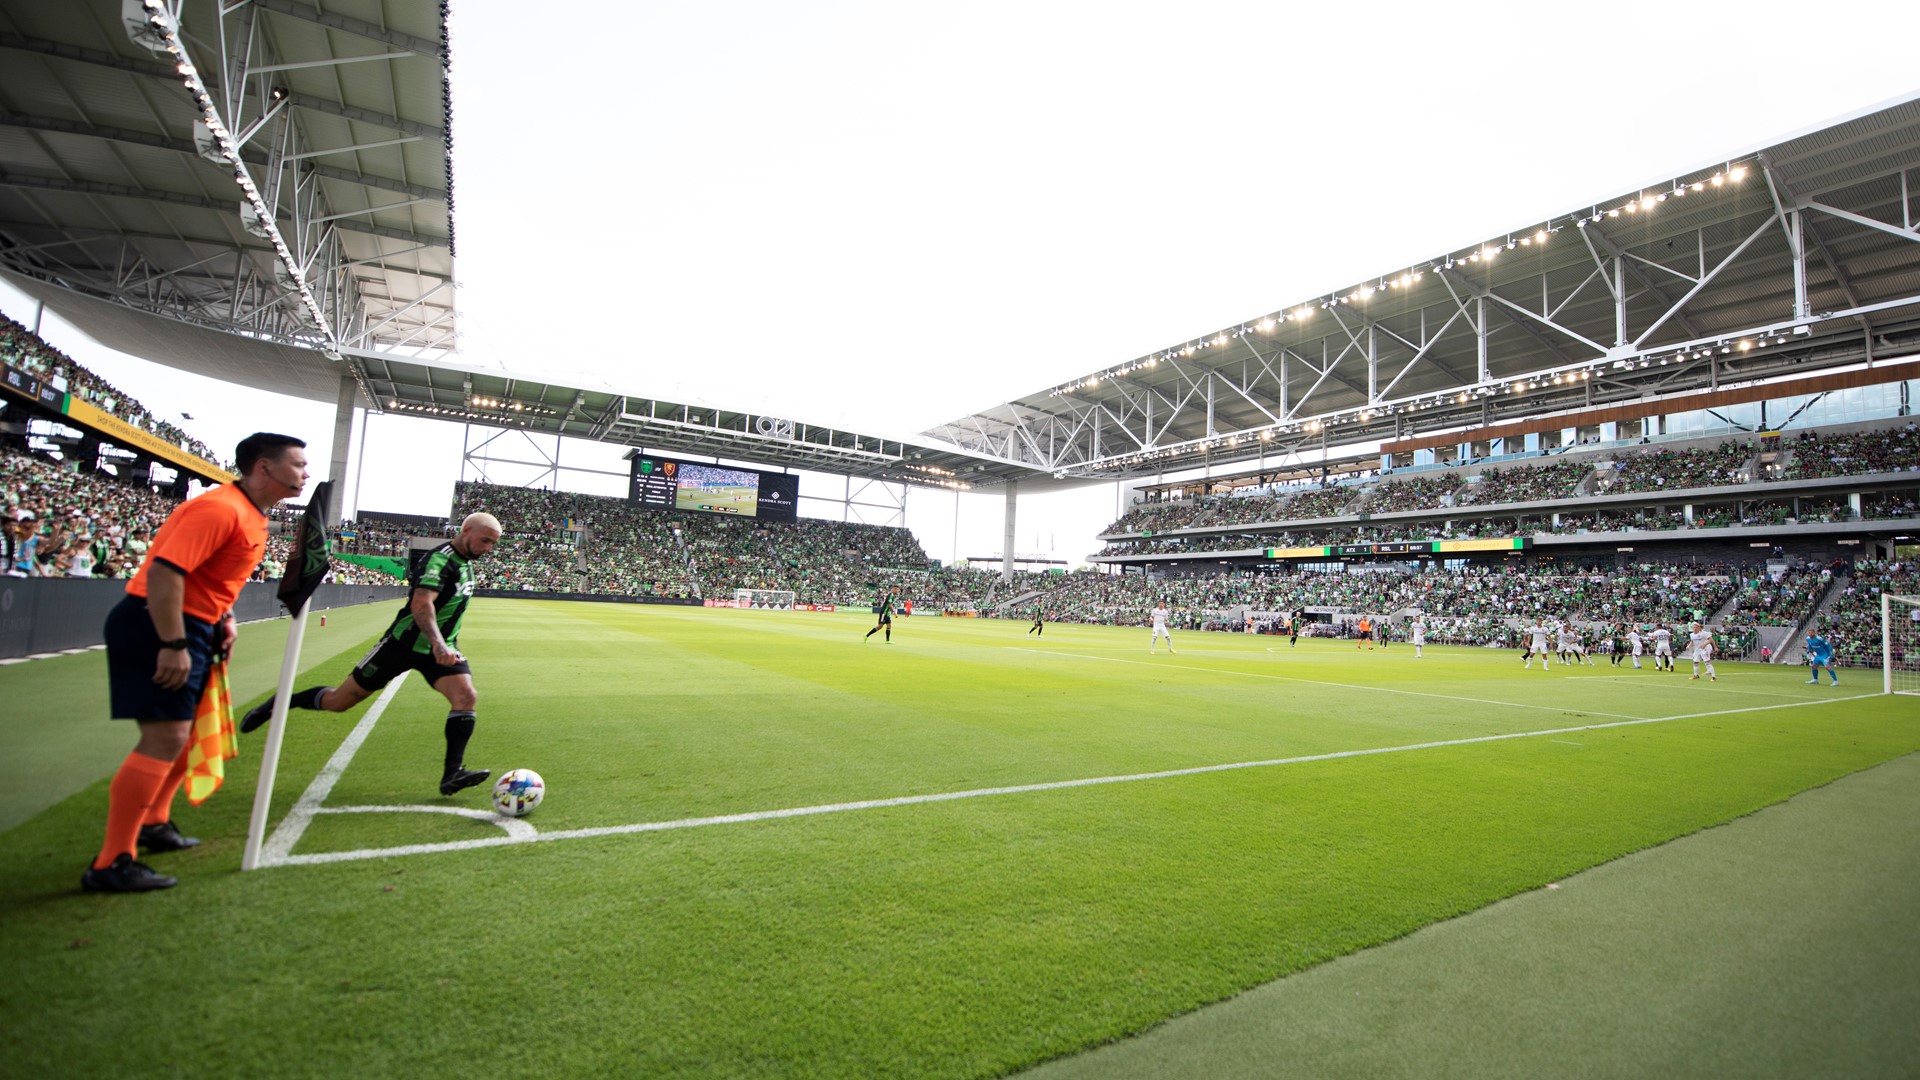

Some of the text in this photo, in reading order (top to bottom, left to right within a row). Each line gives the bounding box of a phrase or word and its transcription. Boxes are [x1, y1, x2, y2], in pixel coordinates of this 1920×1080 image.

[8, 371, 37, 394] RSL 2
[755, 416, 791, 439] Q2
